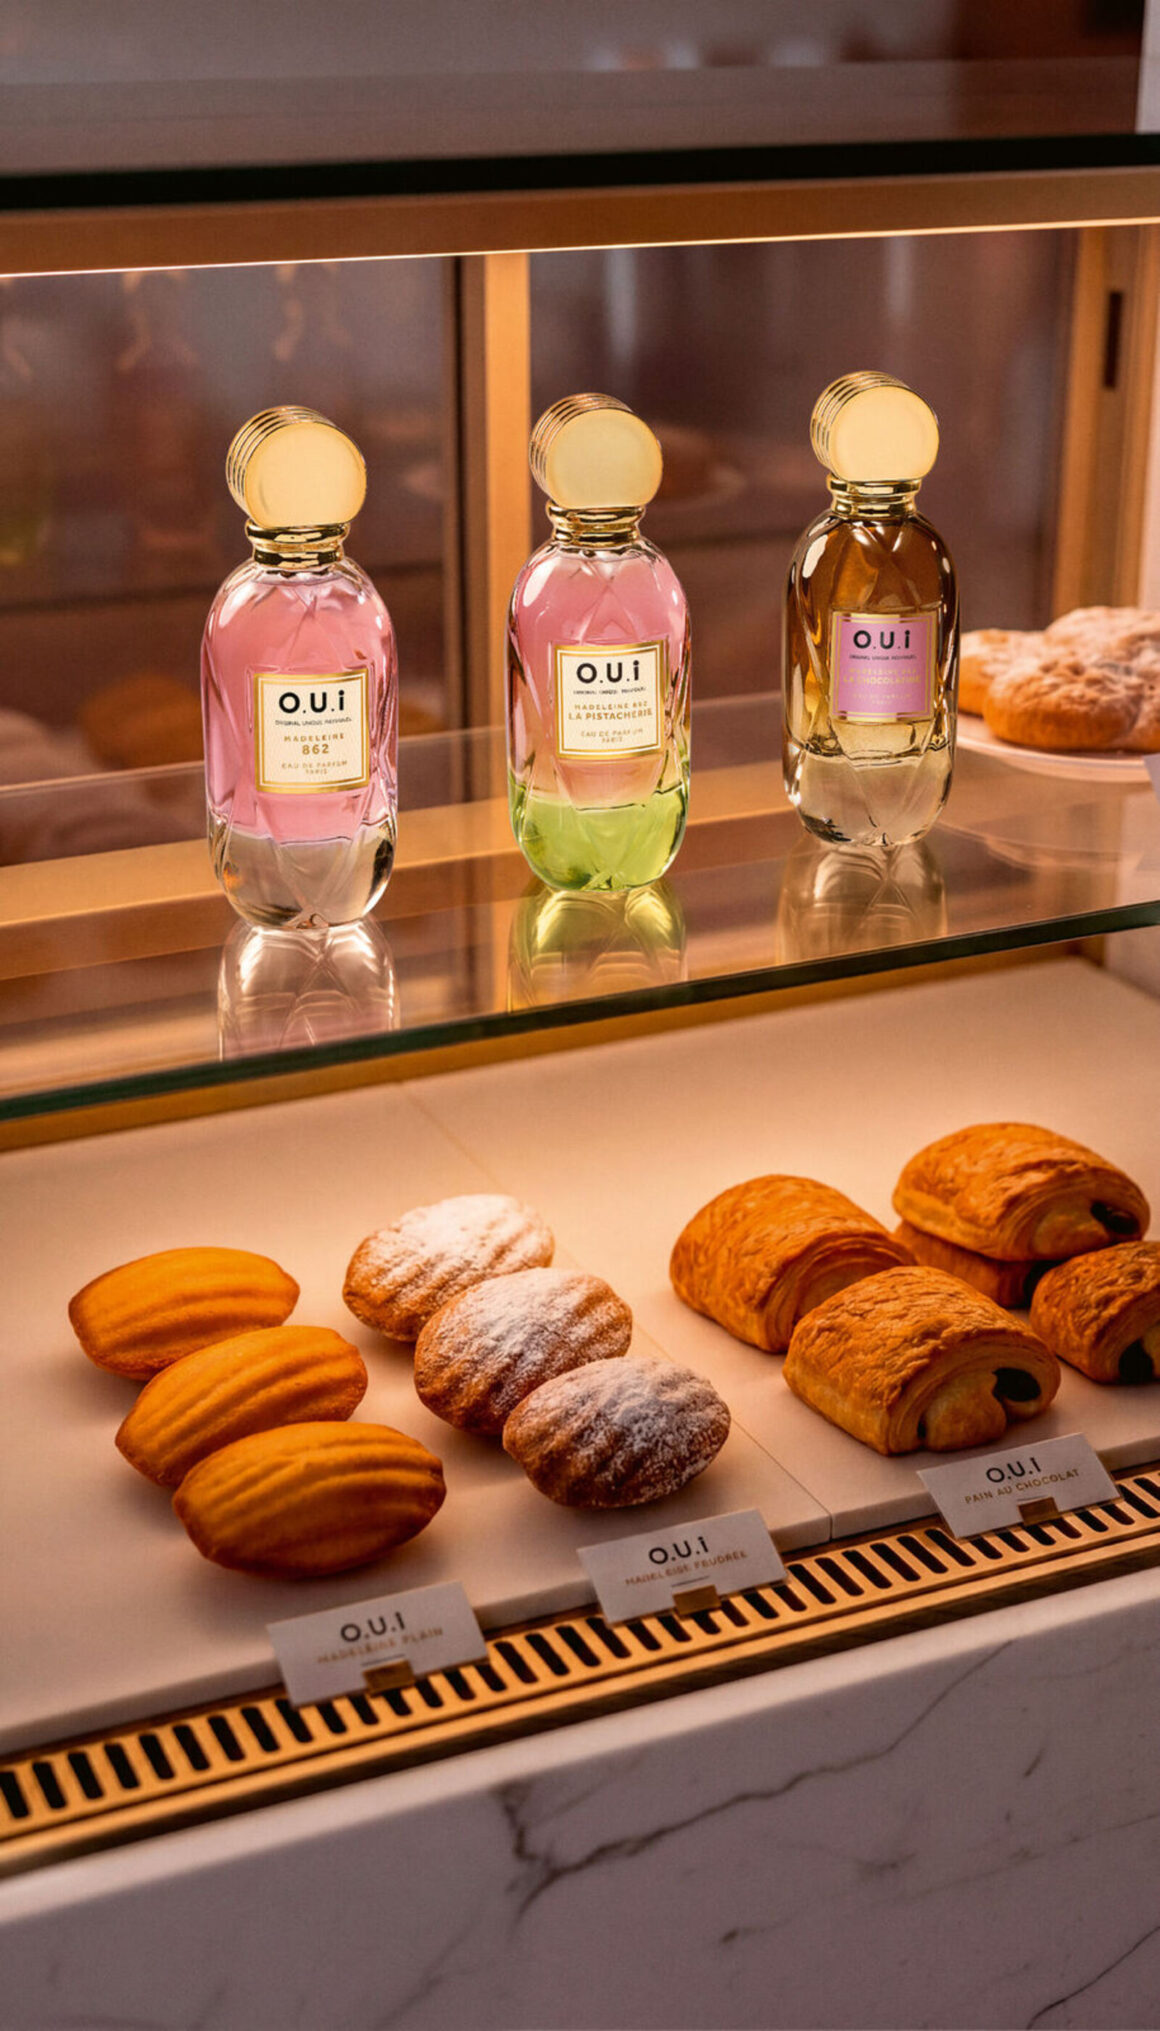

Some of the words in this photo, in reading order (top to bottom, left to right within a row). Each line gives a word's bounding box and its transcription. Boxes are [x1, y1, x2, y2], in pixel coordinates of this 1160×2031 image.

[853, 629, 911, 650] O.U.i
[576, 659, 640, 685] O.U.i
[278, 689, 346, 714] O.U.i
[568, 711, 582, 721] LA
[585, 707, 653, 721] PISTACHERIE
[302, 743, 330, 756] 862
[964, 1489, 994, 1505] PAIN
[996, 1484, 1014, 1497] AU
[1015, 1468, 1081, 1492] CHOCOLAT
